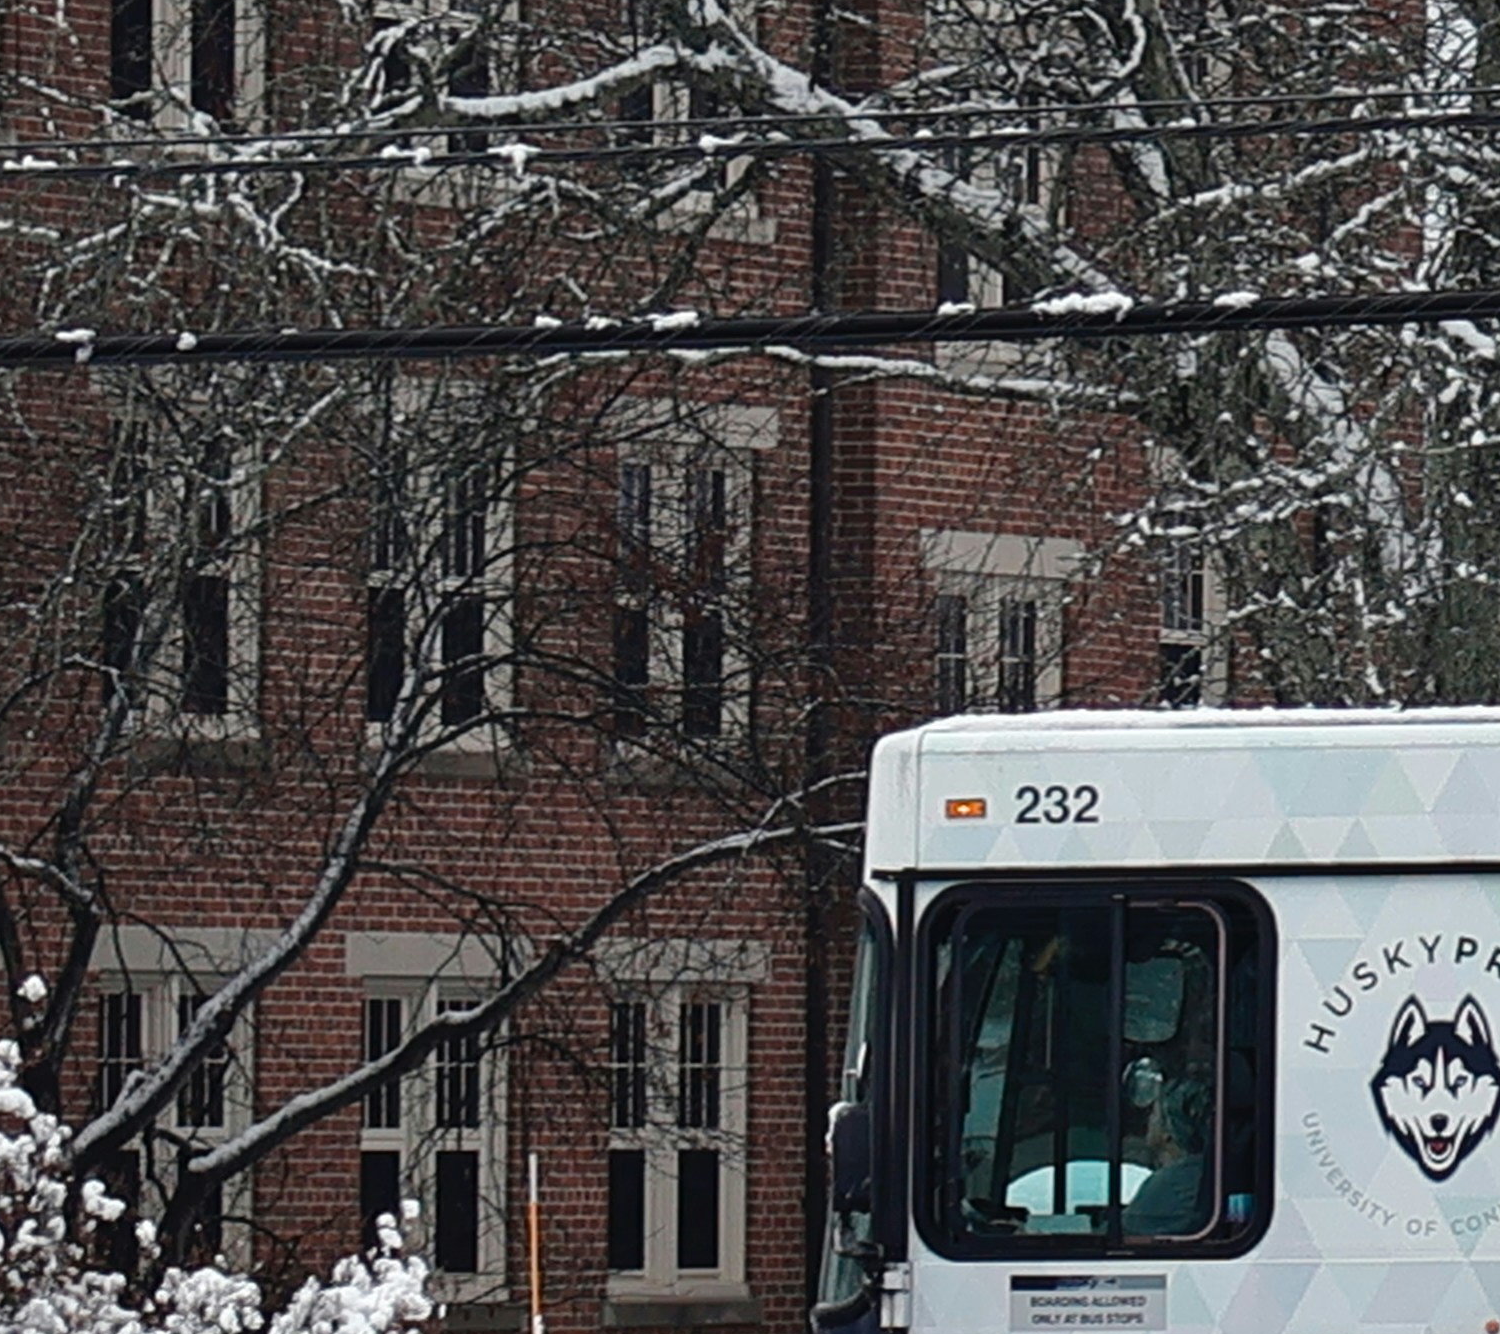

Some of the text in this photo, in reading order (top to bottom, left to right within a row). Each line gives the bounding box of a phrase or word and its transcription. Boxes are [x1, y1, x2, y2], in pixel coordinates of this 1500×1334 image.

[1015, 785, 1099, 824] 232
[1302, 1112, 1398, 1227] UNIVERSITY
[1406, 1219, 1439, 1237] OF
[1030, 1296, 1146, 1307] BOARDING ALLOWED
